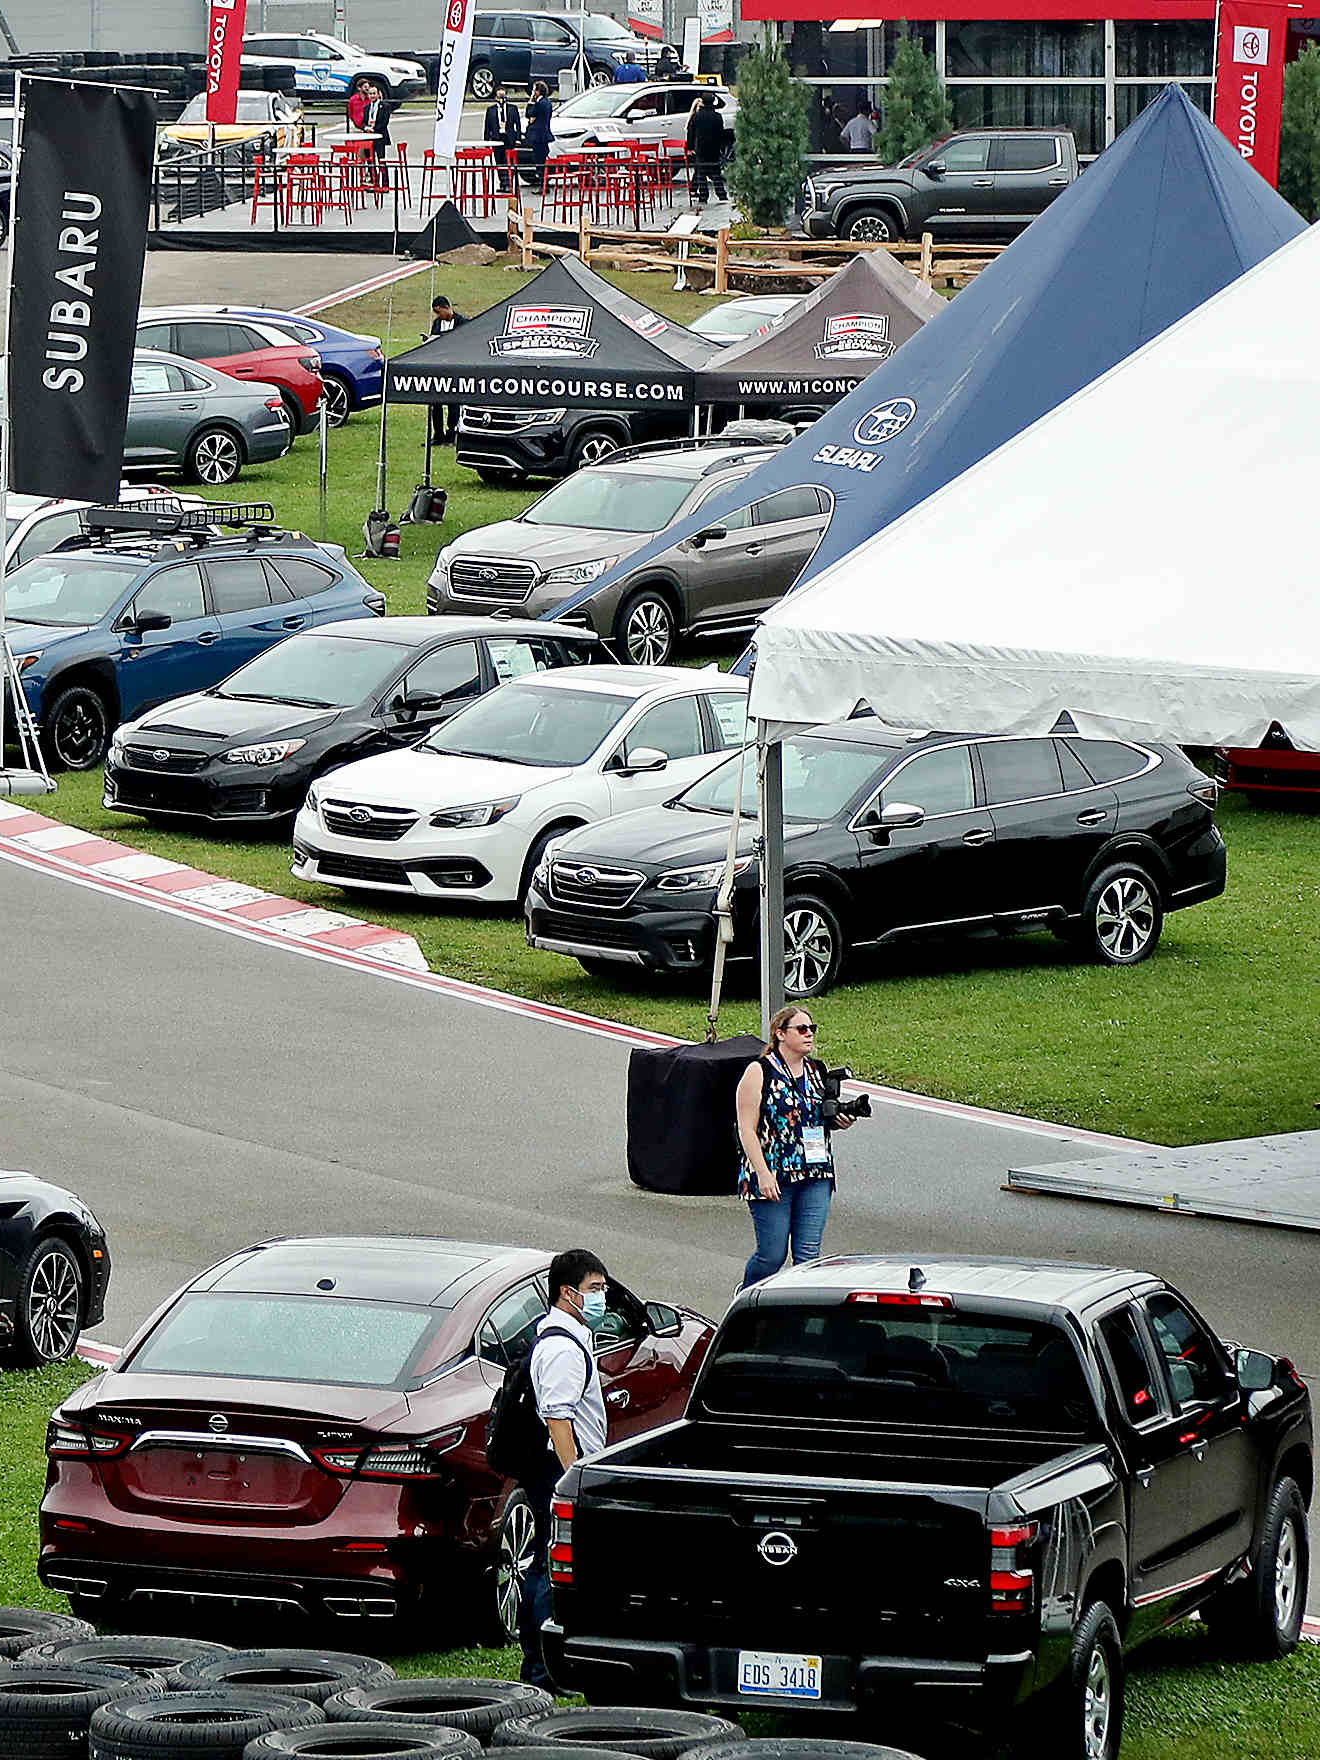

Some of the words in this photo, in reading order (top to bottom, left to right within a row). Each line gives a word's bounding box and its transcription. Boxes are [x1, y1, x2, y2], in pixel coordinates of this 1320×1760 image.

[208, 14, 227, 95] TOYOTA
[436, 39, 456, 122] TOYOTA
[1237, 71, 1258, 160] TOYOTA
[42, 191, 103, 393] SUBARU
[516, 314, 581, 325] CHAMPION
[831, 322, 882, 331] CHAMPION
[501, 339, 585, 351] SPEEDWAY
[823, 342, 887, 354] SPEEDWAY
[393, 375, 684, 401] WWW.M1CONCOURSE.COM
[812, 444, 884, 473] SUBARU
[756, 1543, 799, 1555] NISSAN
[743, 1663, 770, 1686] EDS
[780, 1666, 816, 1689] 3418
